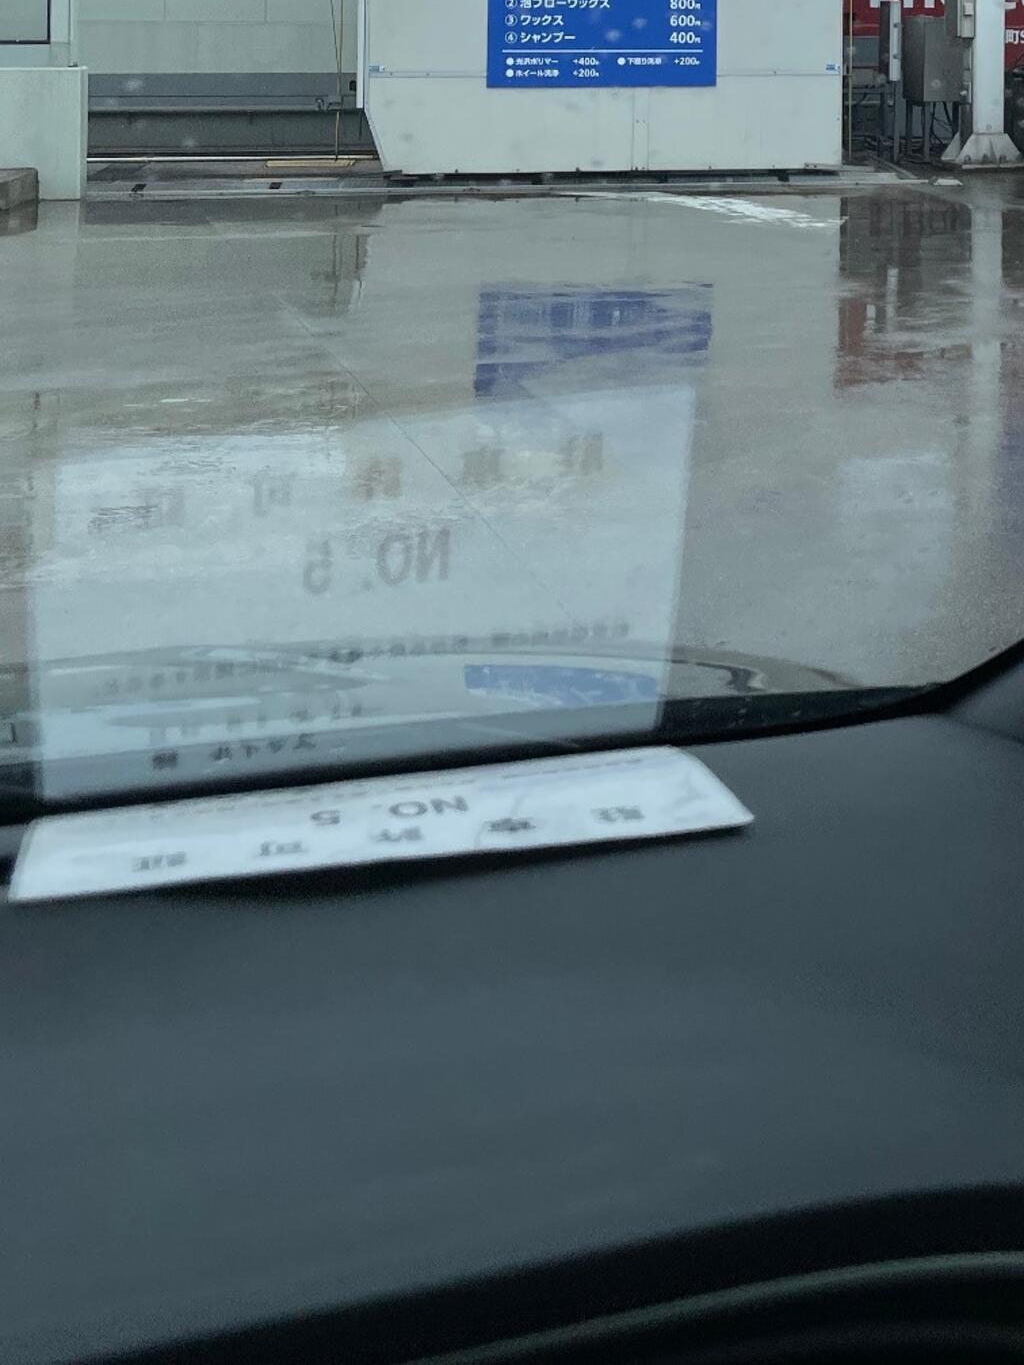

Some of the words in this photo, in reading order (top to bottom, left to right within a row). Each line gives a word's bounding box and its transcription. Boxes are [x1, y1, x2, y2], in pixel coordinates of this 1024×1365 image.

[520, 14, 564, 27] ワックス
[520, 31, 576, 43] シャンプー
